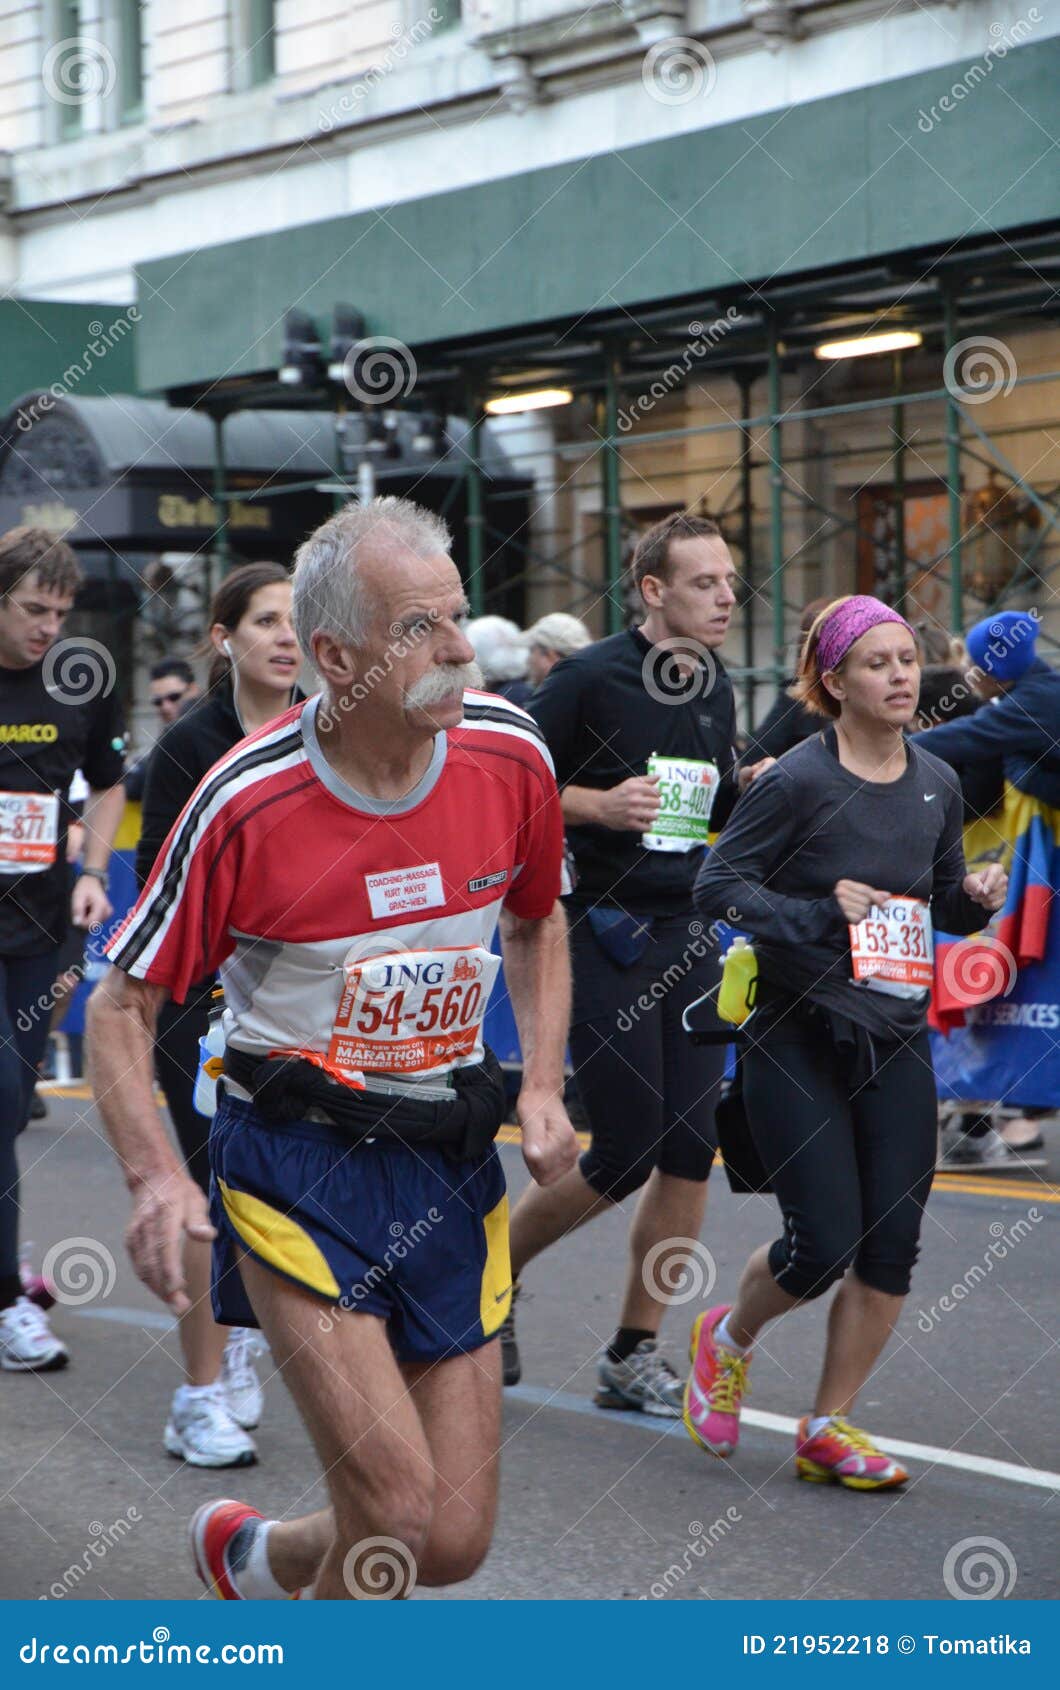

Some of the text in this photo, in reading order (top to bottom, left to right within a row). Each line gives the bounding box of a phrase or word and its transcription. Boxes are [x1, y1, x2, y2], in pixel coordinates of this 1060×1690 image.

[668, 766, 698, 783] ING
[0, 815, 46, 840] -877
[368, 867, 438, 888] COACHING-MASSAGE
[384, 883, 427, 898] KURT MAYER
[865, 922, 927, 958] 53-331
[383, 962, 444, 987] ING
[339, 986, 355, 1018] WAVE
[357, 982, 481, 1035] 54-560
[335, 1056, 392, 1068] NOVEMBER
[336, 1046, 425, 1061] MARATHON
